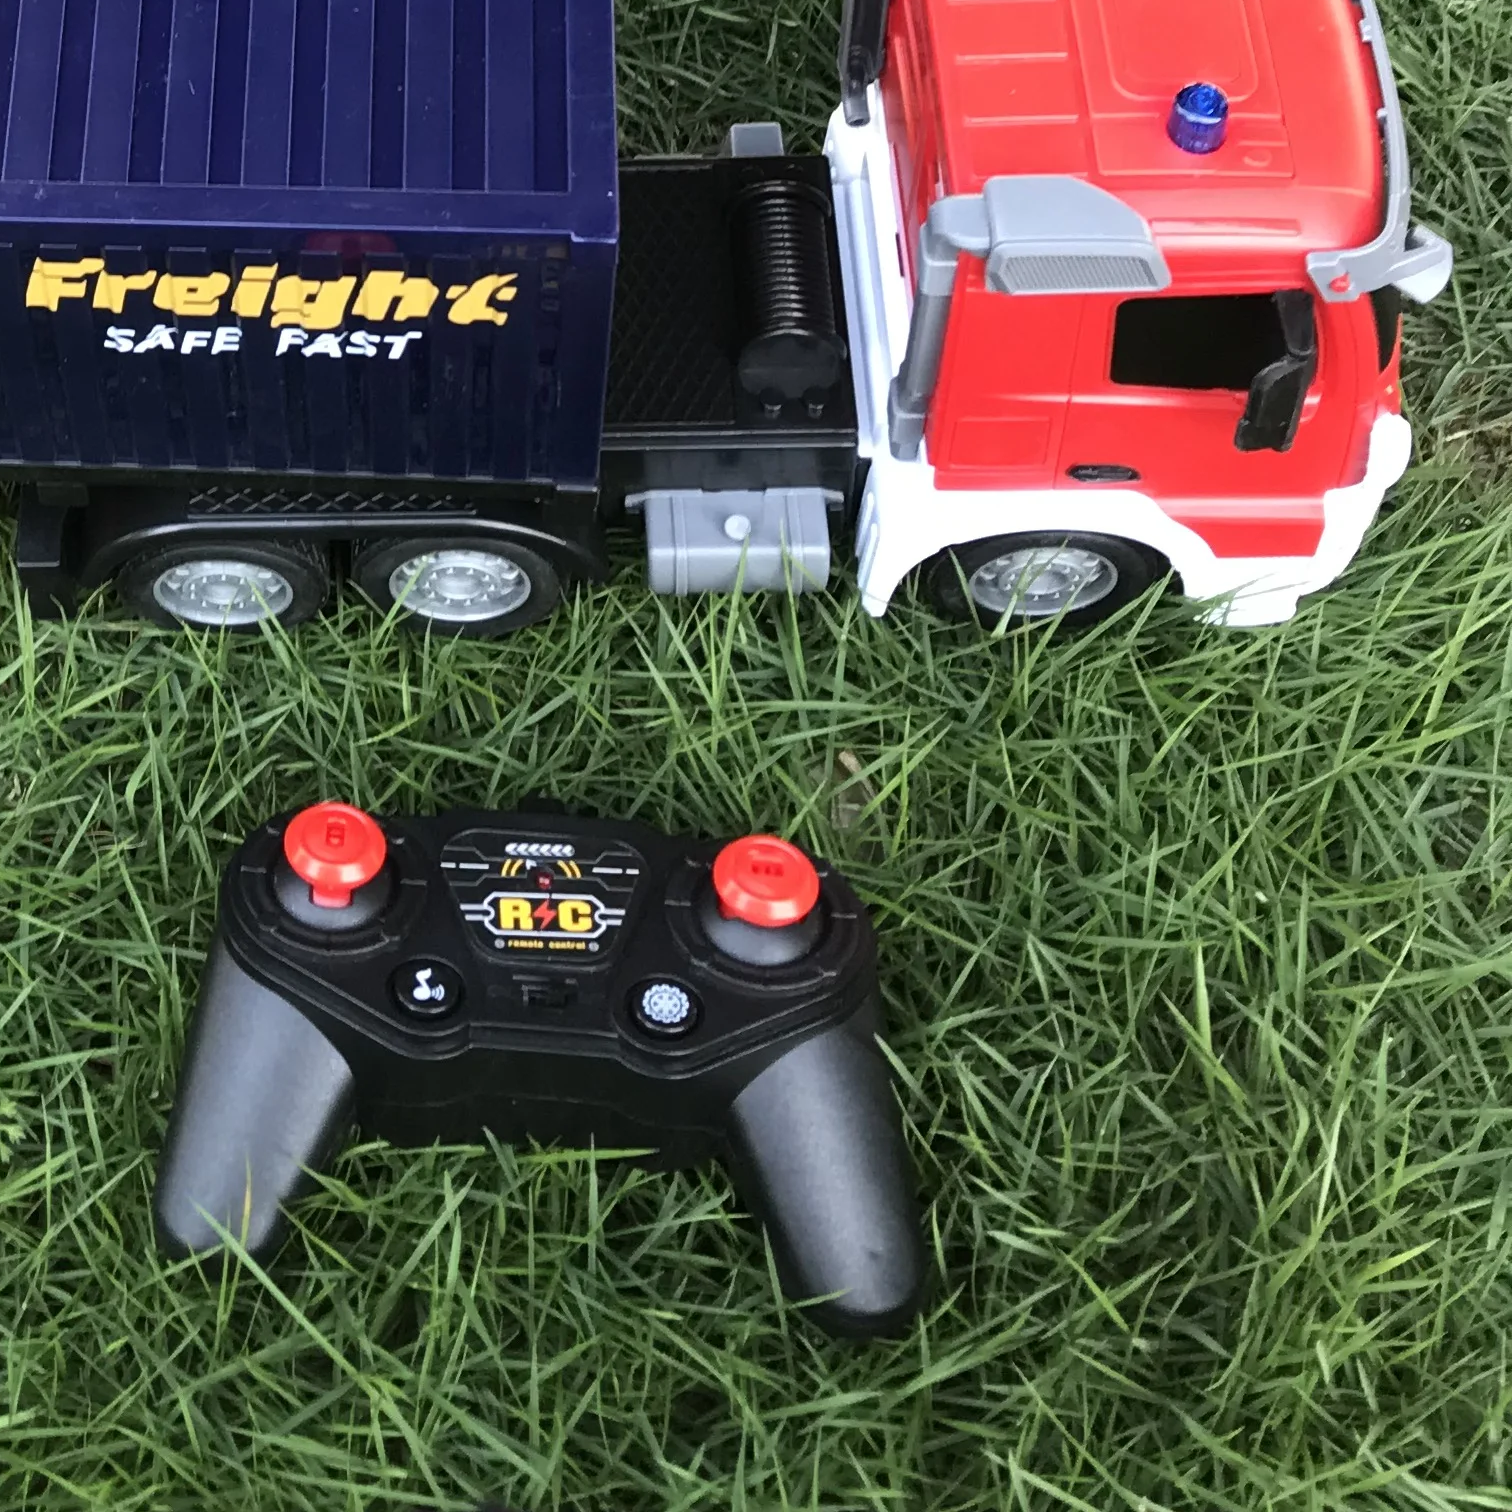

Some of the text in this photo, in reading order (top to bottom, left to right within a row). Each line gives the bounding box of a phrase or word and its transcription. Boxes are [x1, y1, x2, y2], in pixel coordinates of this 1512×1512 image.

[25, 257, 518, 329] Freight
[103, 324, 423, 360] SAFE FAST
[508, 939, 586, 950] remote control
